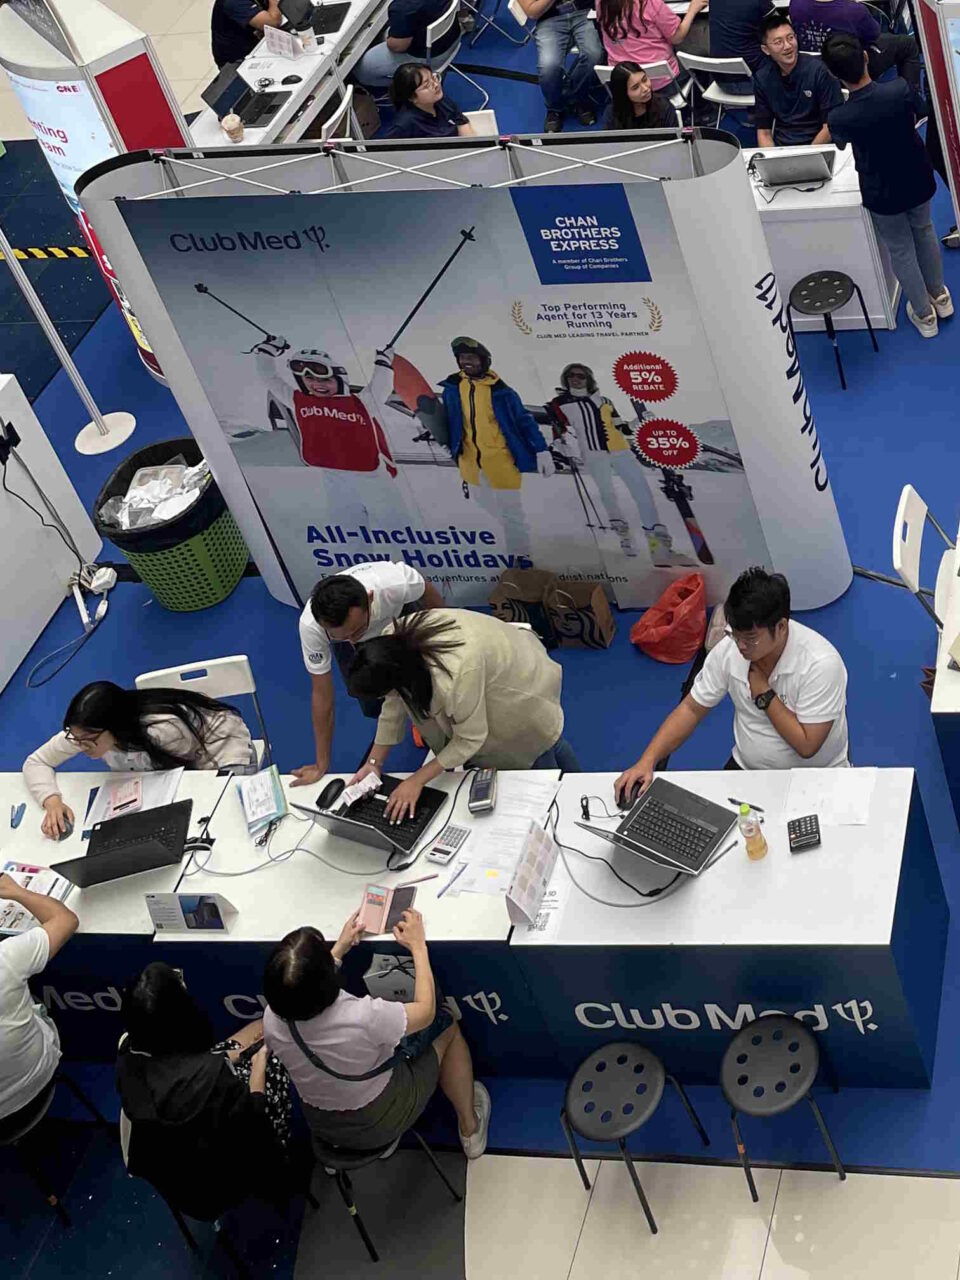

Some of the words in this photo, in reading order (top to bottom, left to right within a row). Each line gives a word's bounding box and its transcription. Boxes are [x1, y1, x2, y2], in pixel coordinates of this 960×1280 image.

[555, 216, 598, 227] CHAN
[540, 227, 621, 240] BROTHERS
[550, 239, 619, 252] EXPRESS
[588, 263, 619, 271] Companies
[542, 303, 561, 314] Top
[564, 302, 626, 313] Performing
[536, 312, 568, 322] Agent
[572, 311, 588, 320] for
[590, 311, 604, 320] 13
[606, 310, 638, 320] Years
[567, 319, 612, 329] Running
[623, 363, 662, 371] Additional
[630, 371, 662, 383] 5%
[646, 437, 690, 449] 35%
[306, 524, 496, 546] All-Inclusive
[312, 549, 390, 568] Snow
